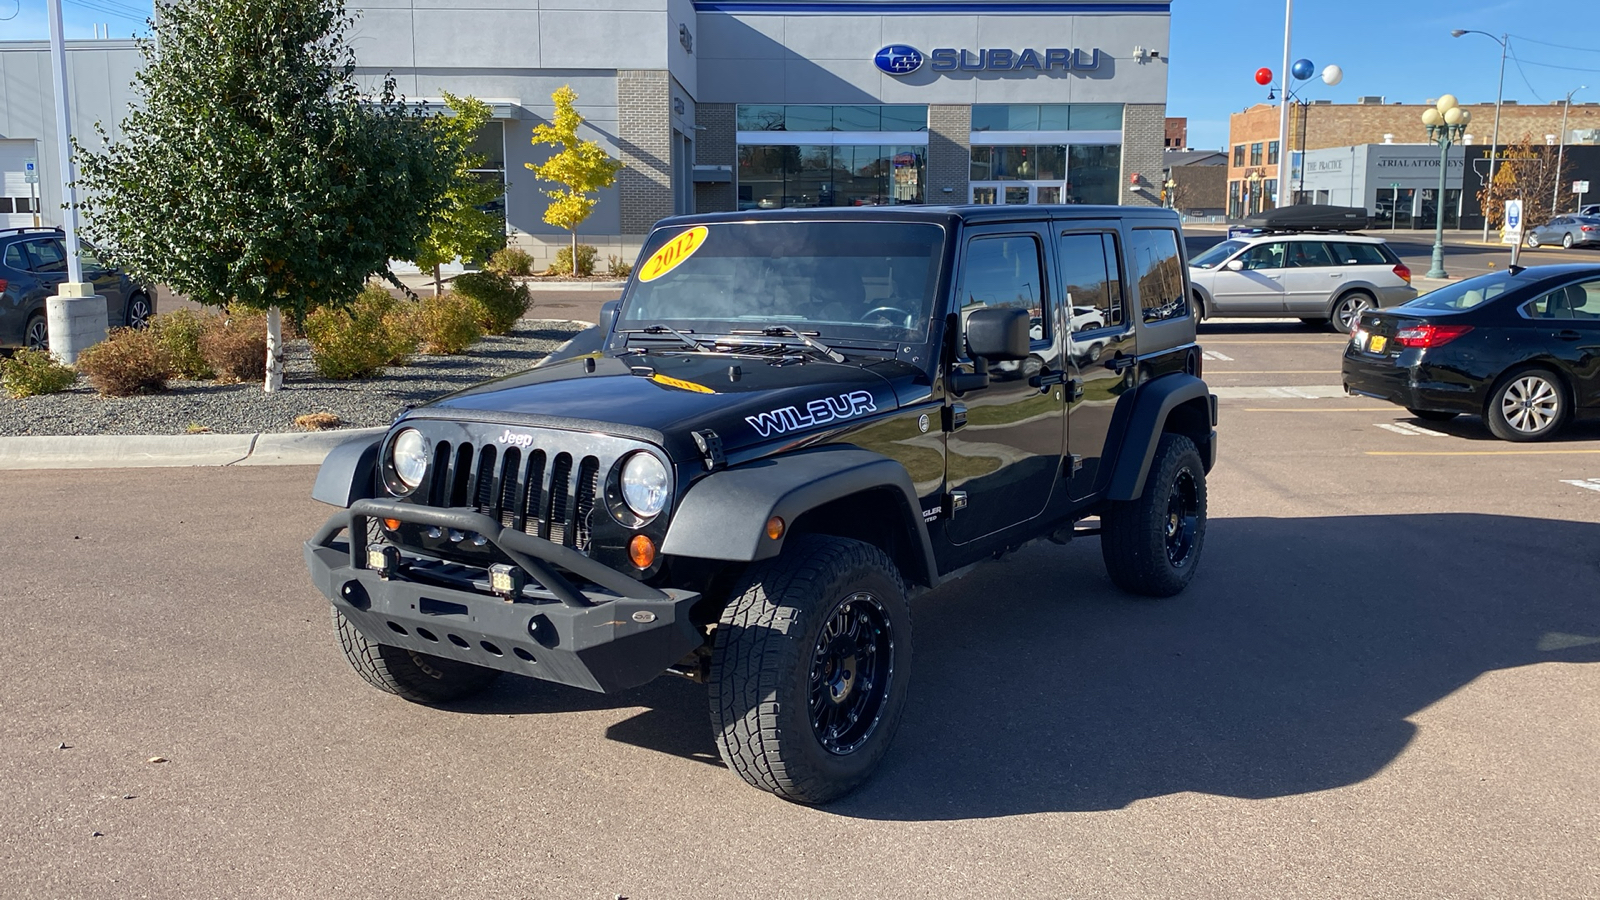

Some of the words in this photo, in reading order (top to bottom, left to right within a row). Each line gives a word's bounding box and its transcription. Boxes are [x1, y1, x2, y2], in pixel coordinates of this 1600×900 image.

[932, 48, 1100, 71] SUBARU
[1307, 162, 1317, 171] THE
[1318, 160, 1343, 170] PRACTICE
[1382, 159, 1409, 167] TRIAL
[1412, 159, 1464, 168] ATTOREYS
[652, 232, 694, 275] 2012
[745, 390, 877, 437] WILBUR
[499, 429, 533, 448] Jeep
